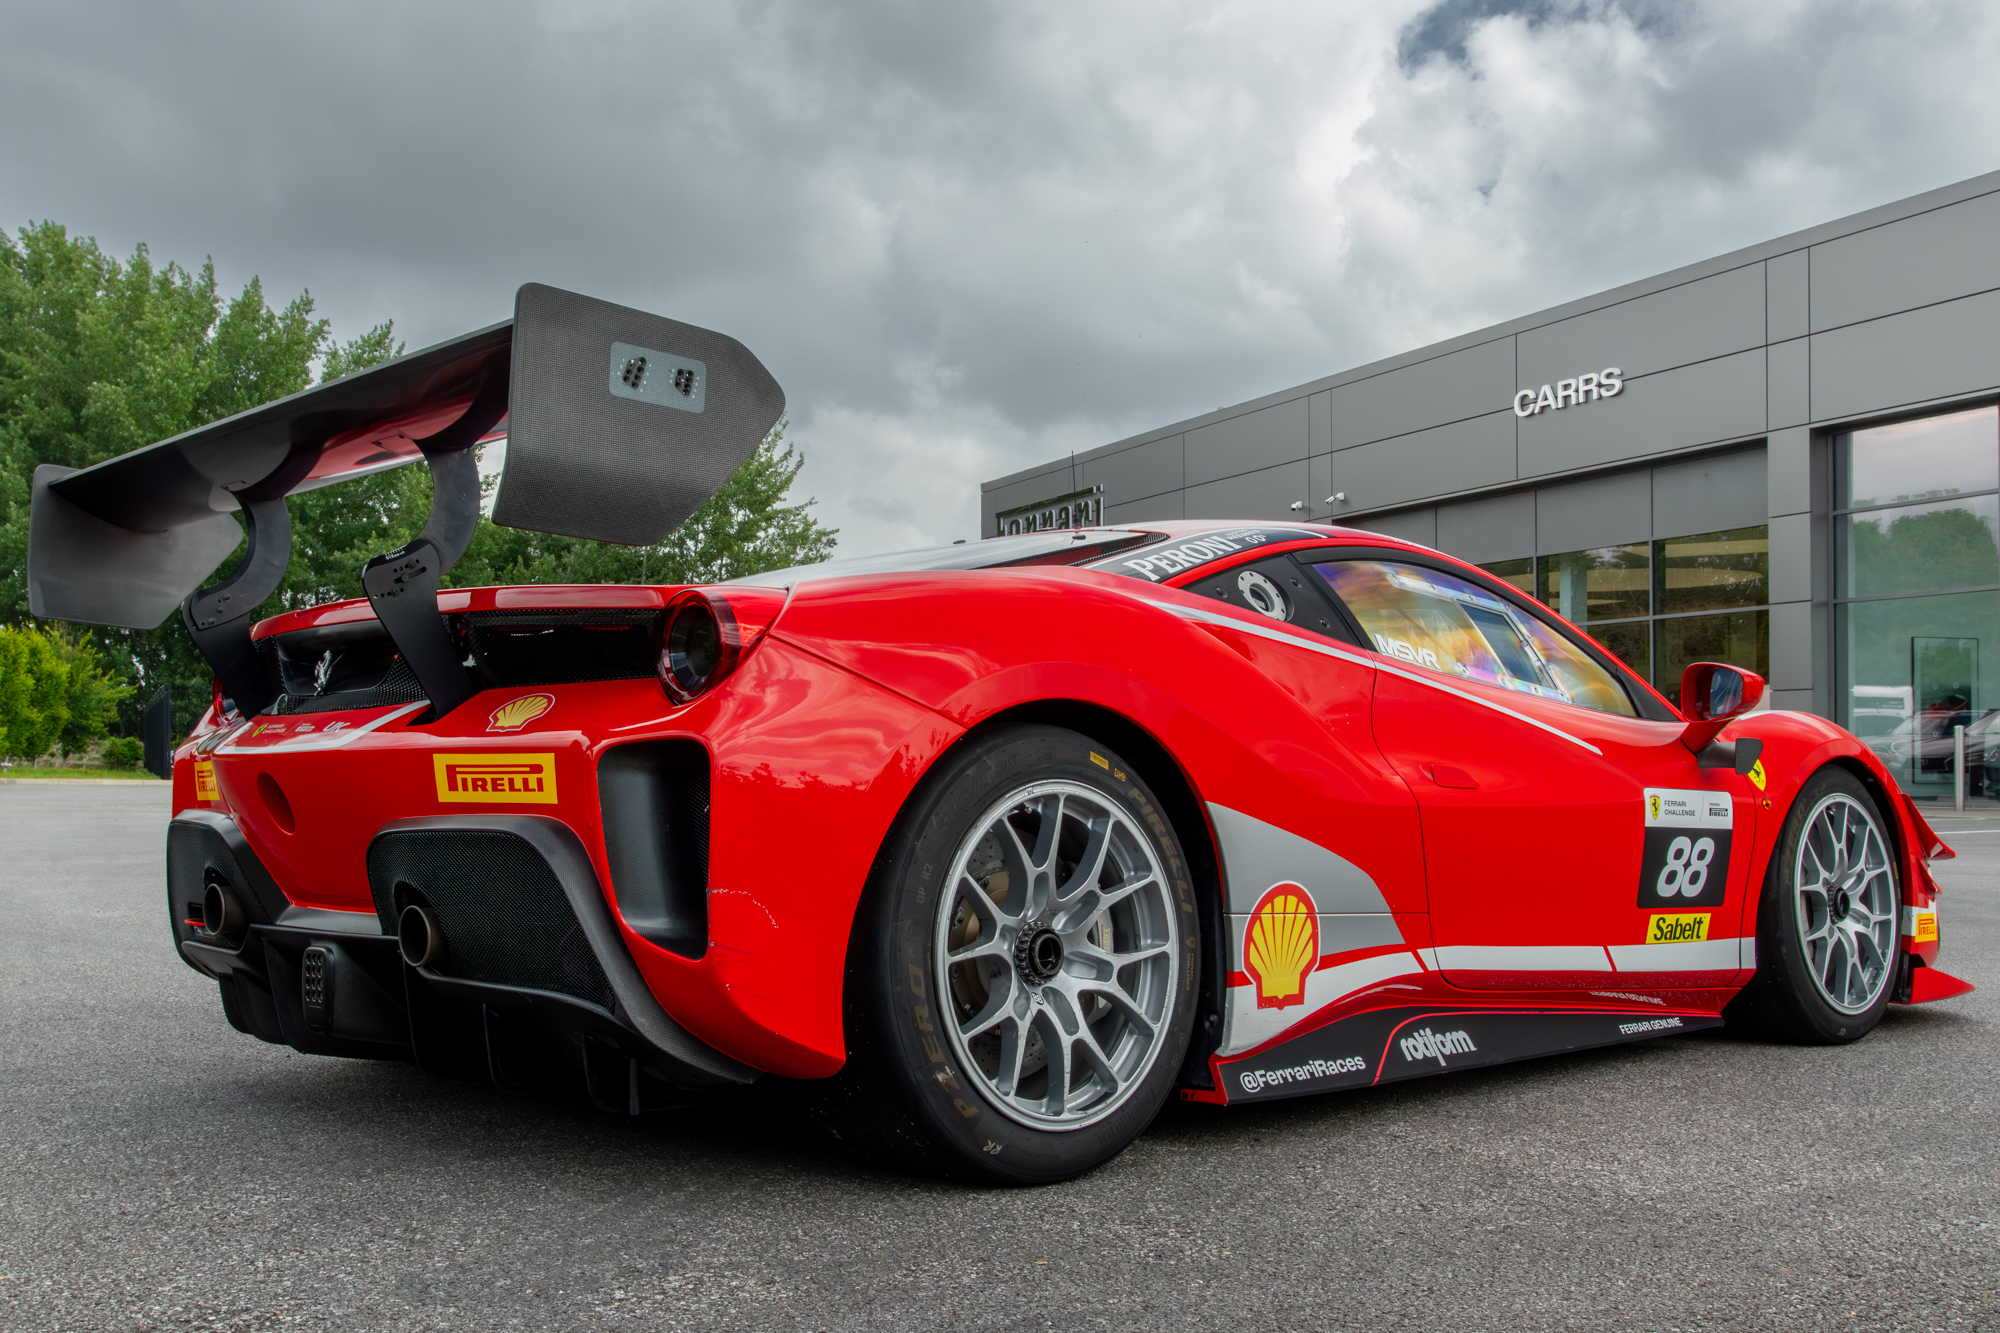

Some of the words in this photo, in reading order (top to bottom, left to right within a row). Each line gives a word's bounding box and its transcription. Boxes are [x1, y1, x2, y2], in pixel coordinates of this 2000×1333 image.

[1513, 367, 1622, 417] CARRS
[1123, 536, 1242, 581] PERONI
[1374, 633, 1442, 670] MSVR
[322, 721, 351, 733] UK
[445, 763, 544, 792] PIRELLI
[1709, 807, 1728, 817] PIRELLI
[1127, 786, 1193, 913] PIRELLI
[1656, 836, 1715, 897] 88
[1653, 917, 1704, 941] Sabelt
[908, 963, 960, 1093] ZERO
[1619, 1021, 1652, 1035] FERRARI
[1650, 1017, 1683, 1030] GENUINE
[1400, 1027, 1477, 1066] rotiform
[1239, 1056, 1366, 1093] @FerrariRaces
[953, 1098, 980, 1118] P
